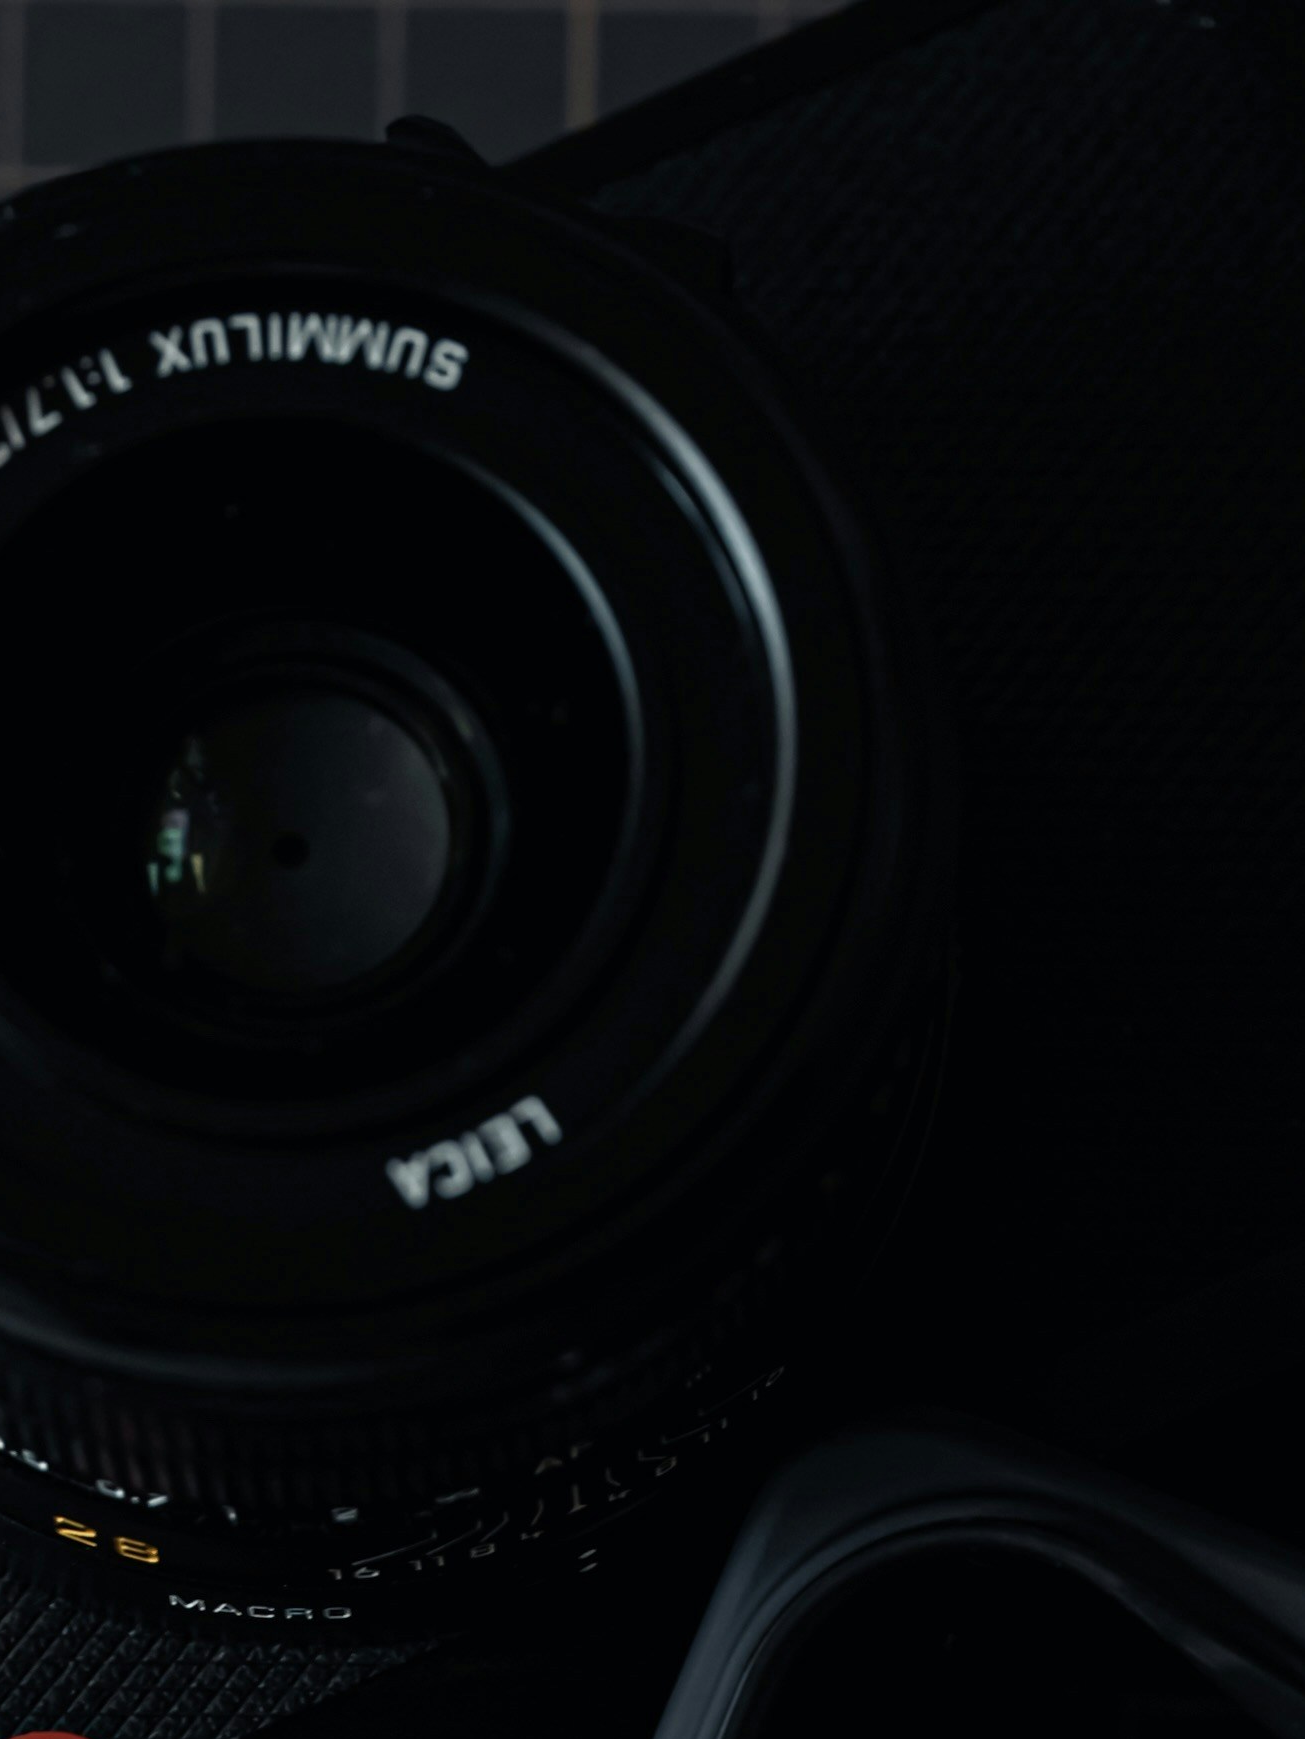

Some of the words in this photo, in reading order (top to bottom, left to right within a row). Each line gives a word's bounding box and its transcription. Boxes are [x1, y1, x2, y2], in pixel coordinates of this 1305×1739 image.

[148, 311, 470, 392] SUMMILUX
[384, 1093, 564, 1211] LEICA
[52, 1514, 161, 1565] 28
[168, 1593, 353, 1621] MACRO
